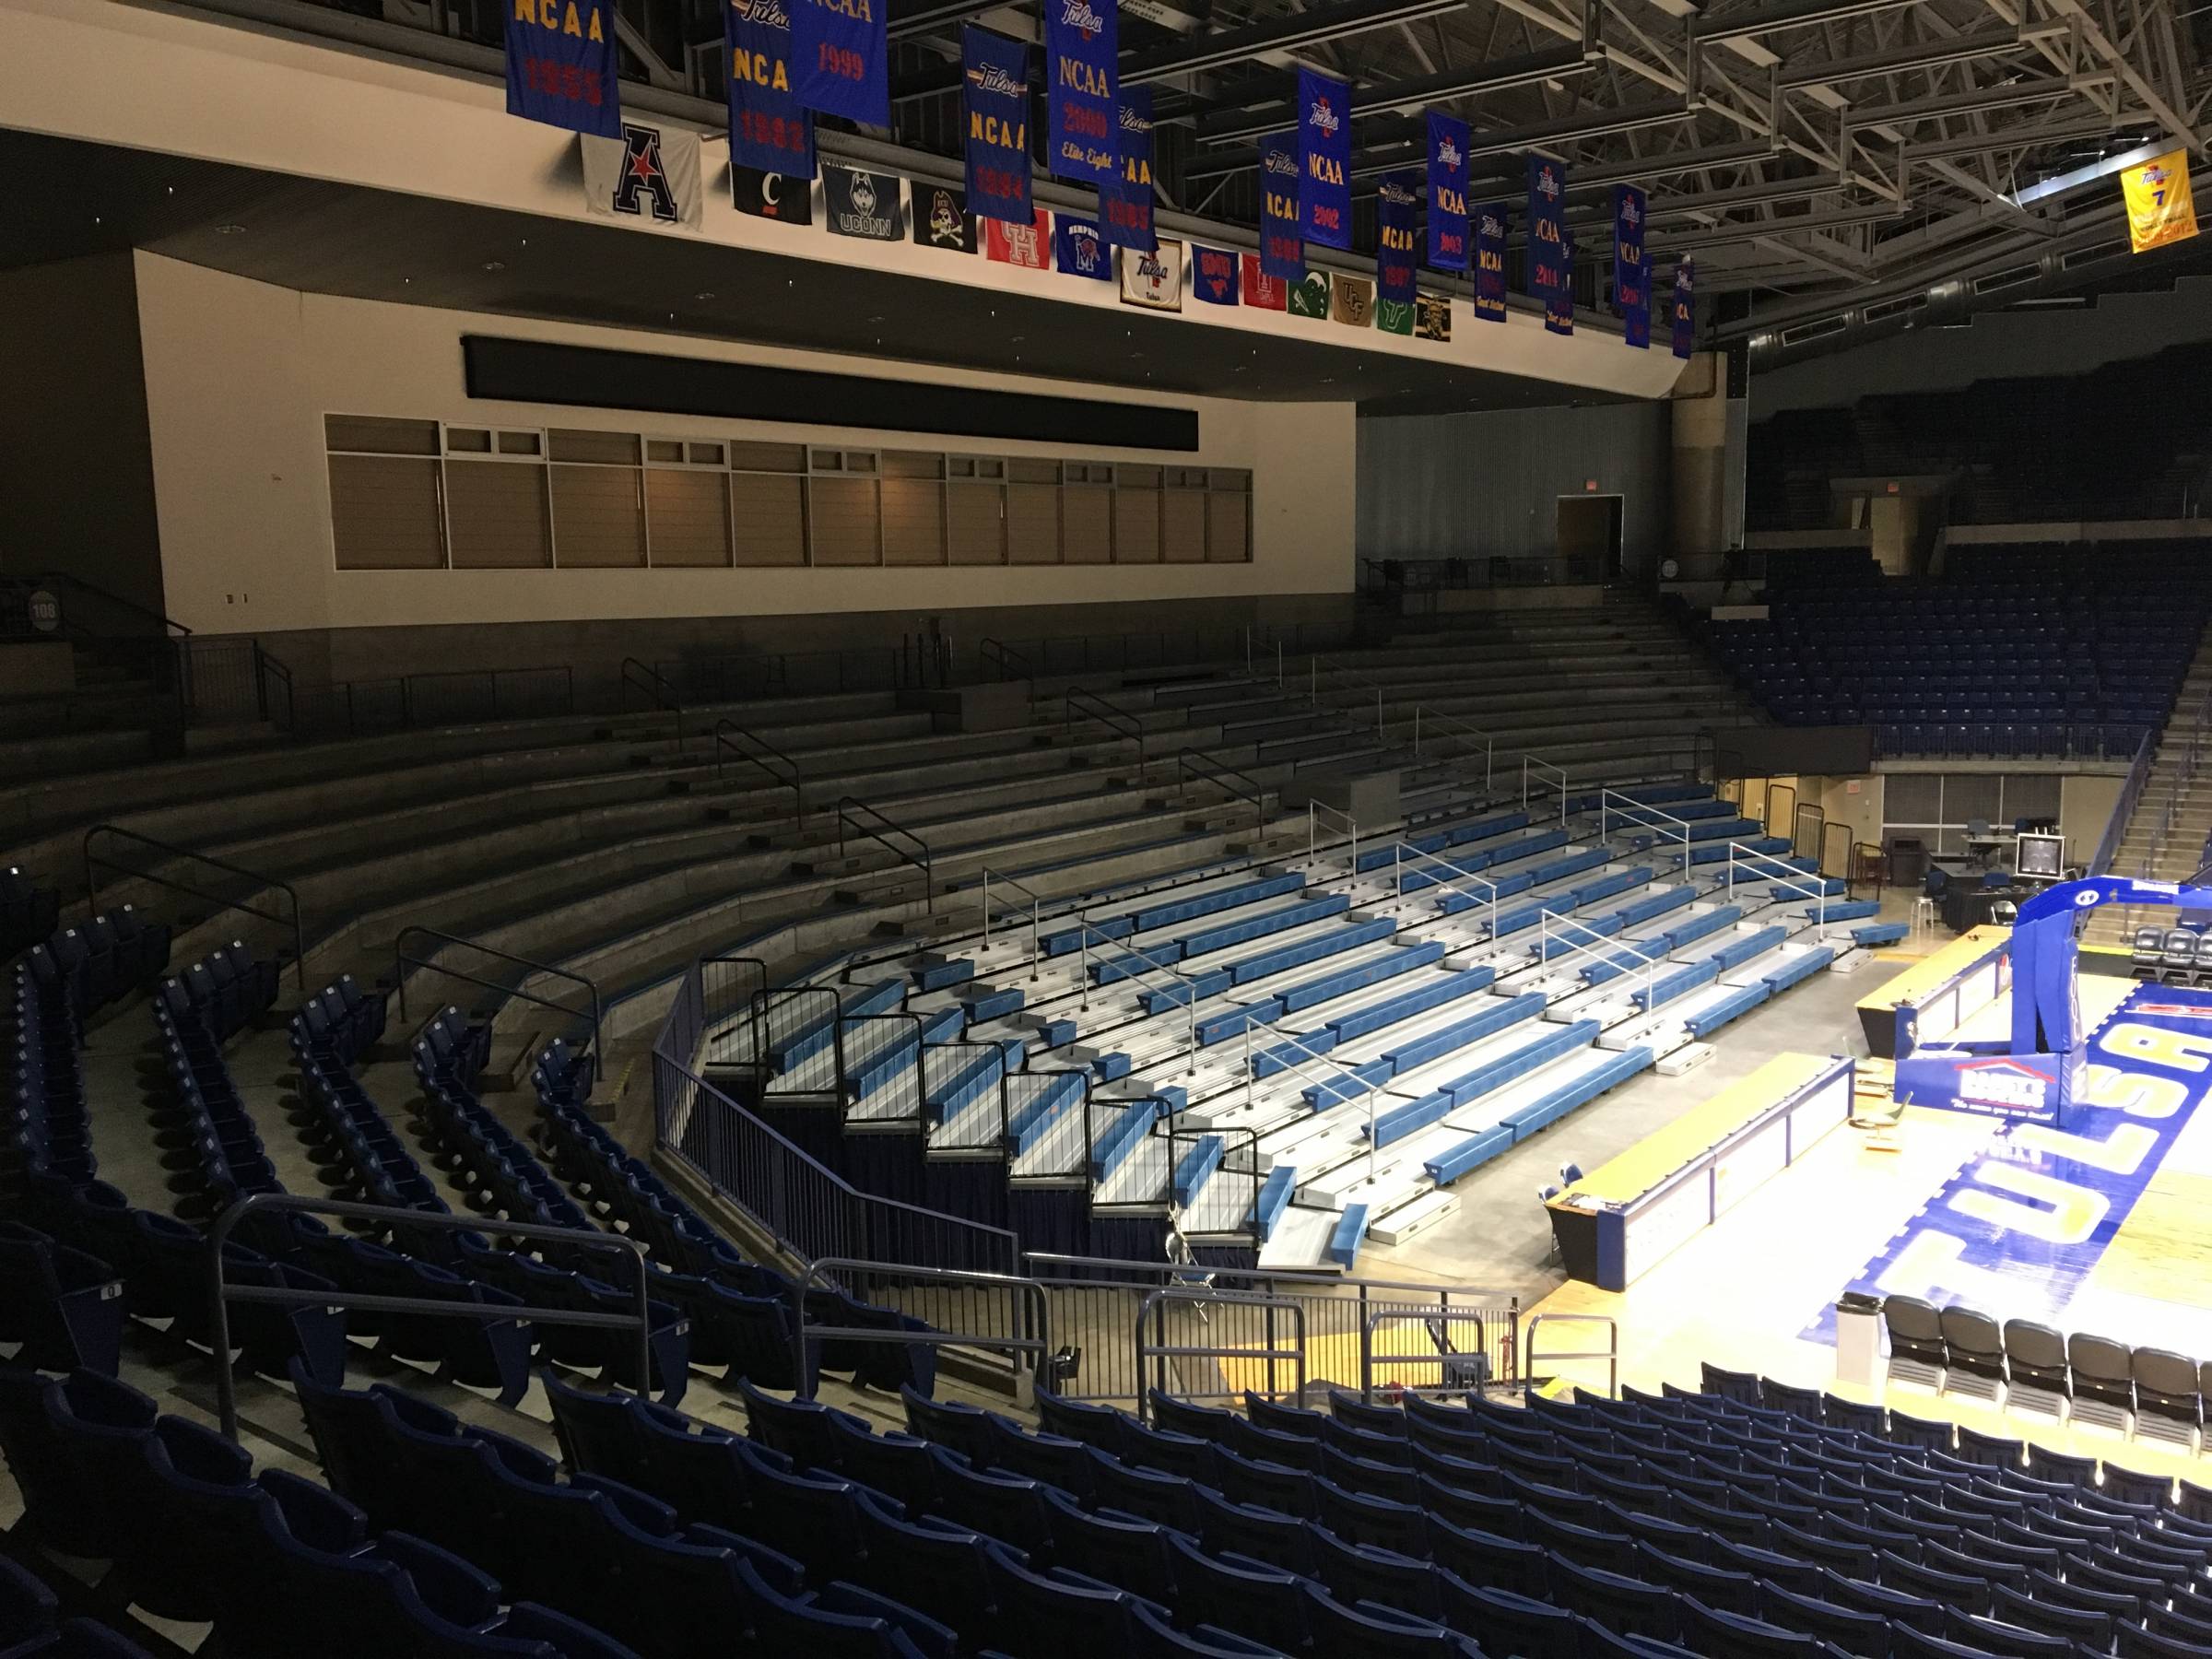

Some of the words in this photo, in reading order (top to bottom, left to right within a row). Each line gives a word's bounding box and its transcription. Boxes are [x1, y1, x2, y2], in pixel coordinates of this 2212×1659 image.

[514, 0, 604, 44] NCAA
[807, 0, 873, 23] AA
[1061, 0, 1103, 33] Tulsa
[733, 46, 793, 92] NCA
[818, 41, 864, 81] 1999
[978, 62, 1018, 98] Tulsa
[1060, 55, 1110, 99] NCAA
[971, 110, 1025, 152] NCAA
[1309, 102, 1339, 131] Tulsa
[1062, 141, 1085, 162] Elite
[1087, 147, 1112, 171] Eight
[1309, 150, 1344, 185] NCAA
[1438, 141, 1462, 166] Tulsa
[612, 121, 677, 222] A
[1120, 154, 1152, 185] AA
[2141, 168, 2172, 185] Tulsa
[761, 171, 782, 206] C
[1437, 185, 1467, 216] NCAA
[2152, 190, 2165, 206] 7
[840, 212, 891, 237] UCONN
[1312, 204, 1339, 229] 2002
[1382, 225, 1414, 251] NCAA
[1619, 241, 1641, 265] NCAA
[1135, 256, 1169, 279] Tulsa
[1201, 251, 1231, 279] SMU
[1479, 249, 1502, 272] NCAA
[1342, 280, 1364, 322] UCF
[32, 604, 55, 618] 108
[1873, 1022, 2212, 1318] TULSA
